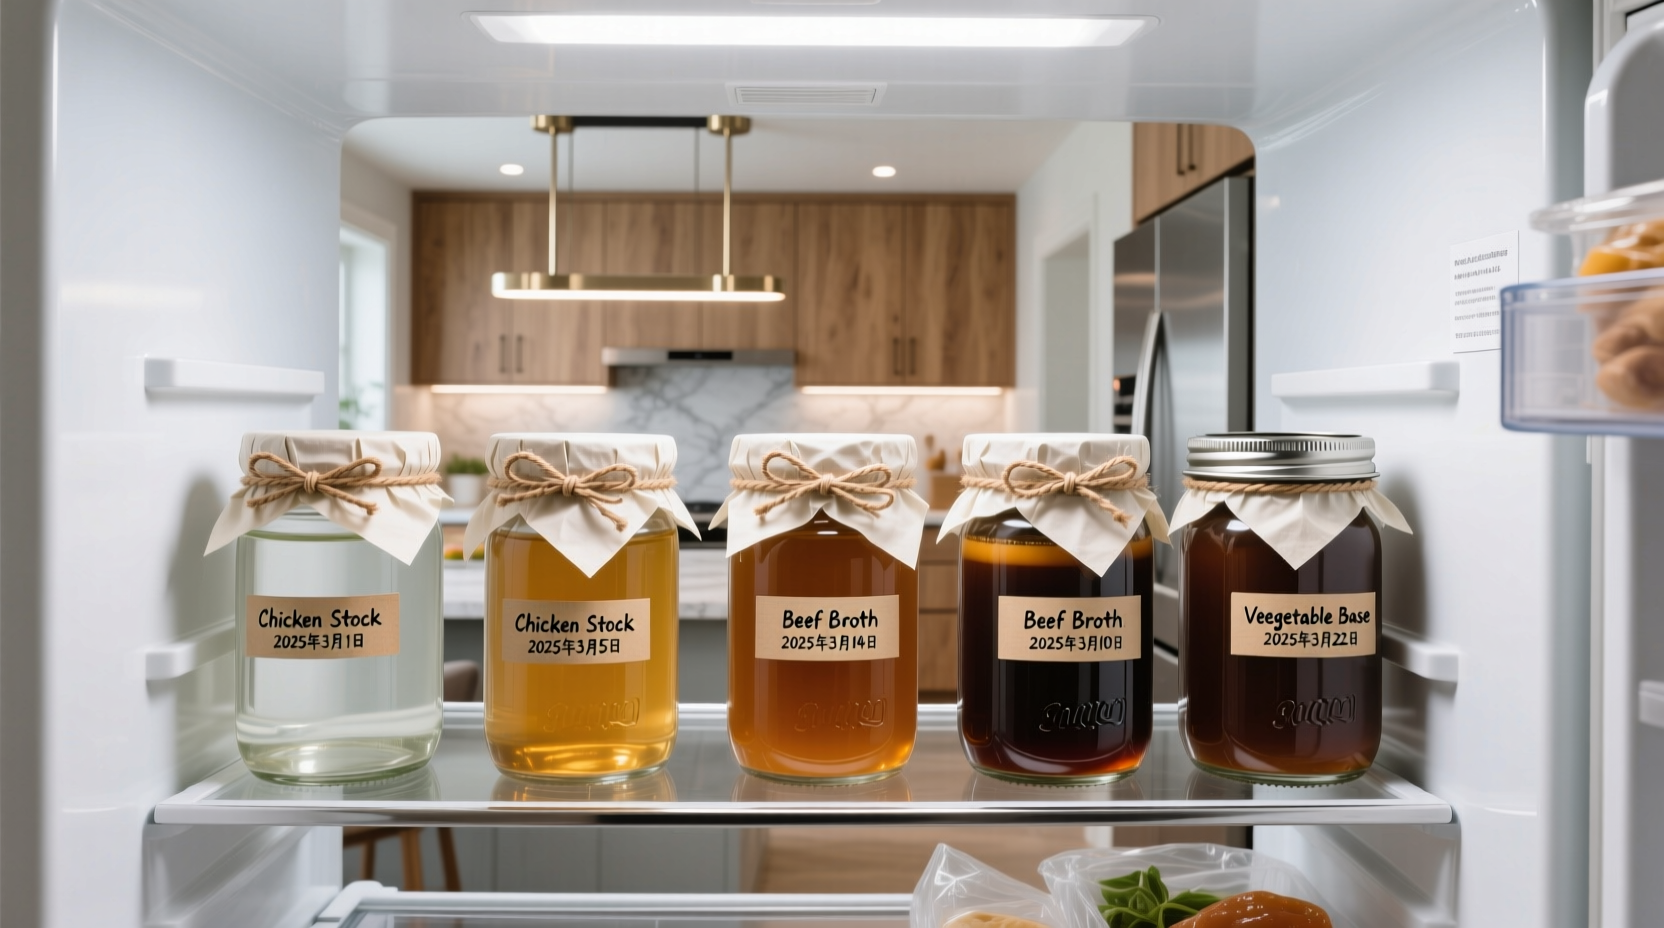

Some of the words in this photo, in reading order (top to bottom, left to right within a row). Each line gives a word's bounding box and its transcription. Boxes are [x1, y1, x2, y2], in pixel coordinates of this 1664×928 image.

[258, 606, 323, 629] Chicken
[329, 607, 383, 629] Stock
[514, 611, 580, 635] Chicken
[585, 612, 635, 634] Stock
[782, 609, 824, 630] Beef
[828, 608, 879, 630] Broth
[1023, 609, 1067, 630] Beef
[1072, 608, 1123, 630] Broth
[1244, 605, 1334, 632] Veegetable
[1338, 606, 1371, 625] Base
[273, 633, 364, 651] 2025年3月1日
[527, 638, 620, 657] 2025年3月5日
[781, 634, 877, 652] 2025年3月14日
[1028, 635, 1123, 652] 2025年3月10日
[1263, 631, 1358, 649] 2025年3月22日
